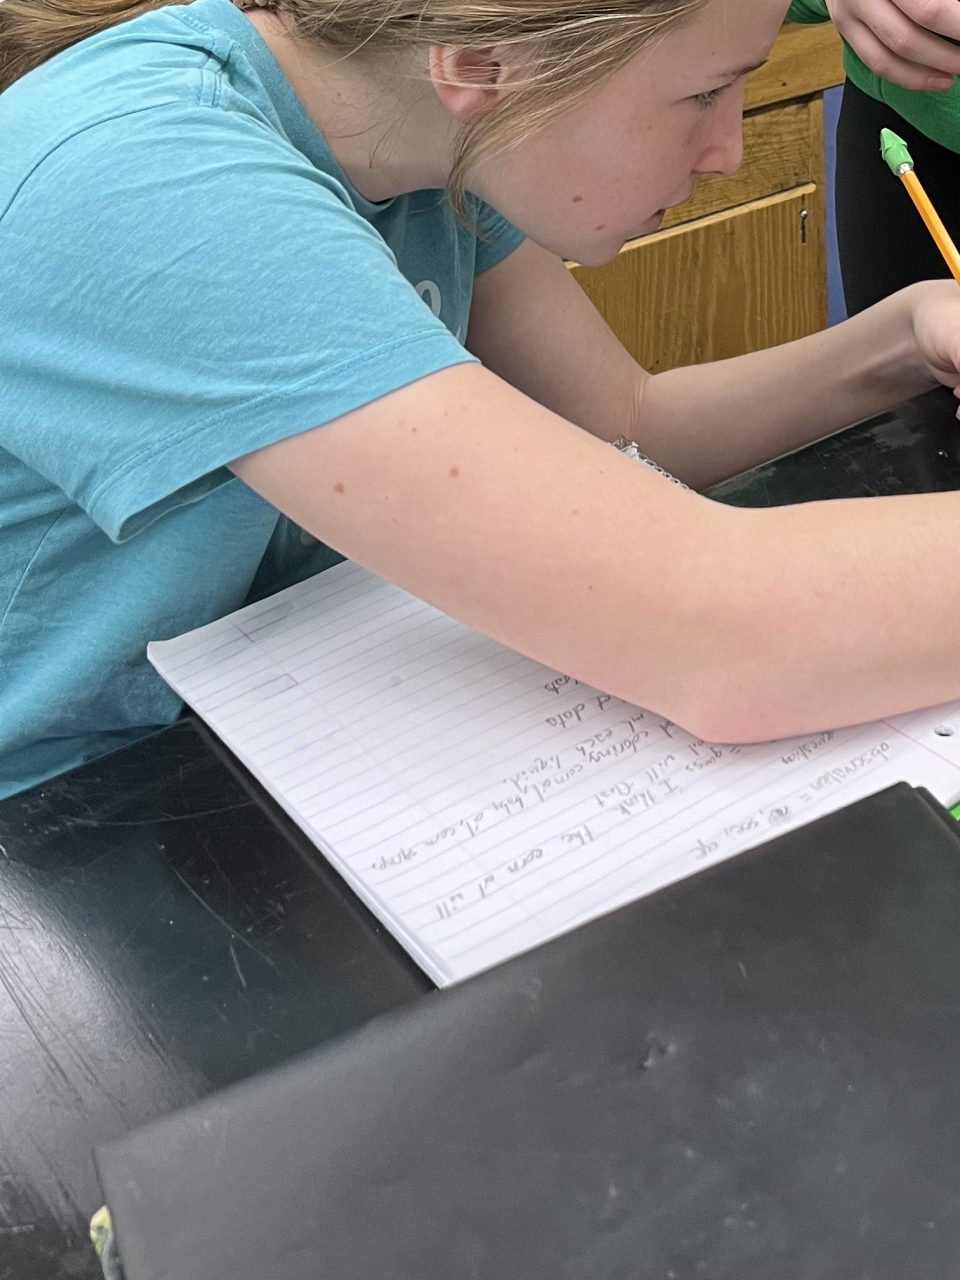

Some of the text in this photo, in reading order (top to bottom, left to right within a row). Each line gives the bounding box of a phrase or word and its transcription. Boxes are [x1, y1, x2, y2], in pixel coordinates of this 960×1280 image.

[544, 702, 585, 728] data
[575, 729, 612, 755] each
[645, 755, 675, 782] will
[561, 824, 594, 846] the
